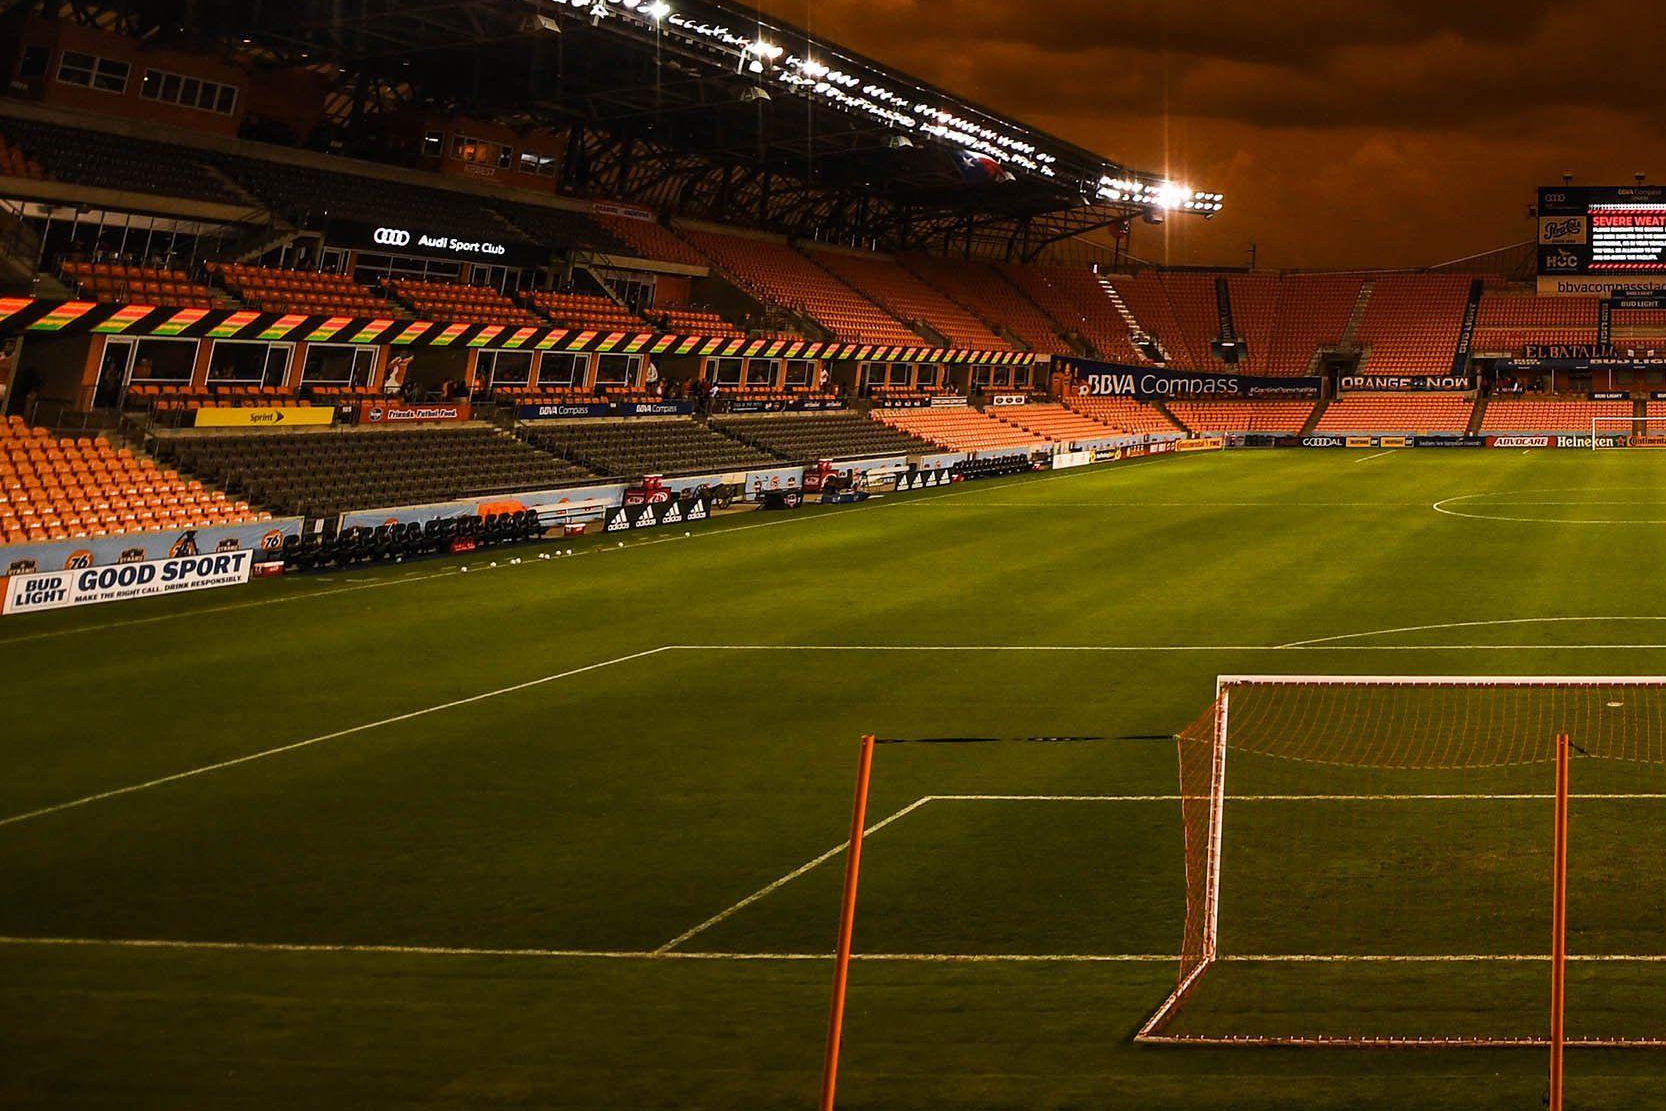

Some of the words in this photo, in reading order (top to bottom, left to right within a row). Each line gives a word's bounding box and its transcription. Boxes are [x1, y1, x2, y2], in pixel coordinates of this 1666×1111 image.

[1592, 216, 1633, 226] SEVERE
[418, 234, 447, 249] Audi
[449, 238, 480, 252] Sport
[481, 242, 505, 255] Club
[1525, 345, 1547, 358] EL
[1089, 374, 1135, 394] BBVA
[1140, 374, 1238, 394] Compass
[1341, 376, 1411, 387] ORANGE
[1426, 376, 1468, 387] NOW
[558, 405, 588, 416] Compass
[652, 404, 677, 414] Compass
[250, 411, 273, 423] Sprint
[1557, 436, 1613, 447] Heineken
[662, 514, 682, 524] adidas
[687, 510, 707, 521] adidas
[607, 521, 630, 532] adidas
[635, 517, 657, 528] adidas
[263, 534, 279, 549] 76
[70, 553, 91, 570] 76
[78, 563, 156, 592] GOOD
[160, 553, 246, 581] SPORT
[25, 577, 62, 592] BUD
[15, 588, 67, 606] LIGHT
[74, 594, 98, 603] MAKE
[100, 592, 115, 600] THE
[116, 589, 141, 598] RIGHT
[164, 582, 189, 591] DRINK
